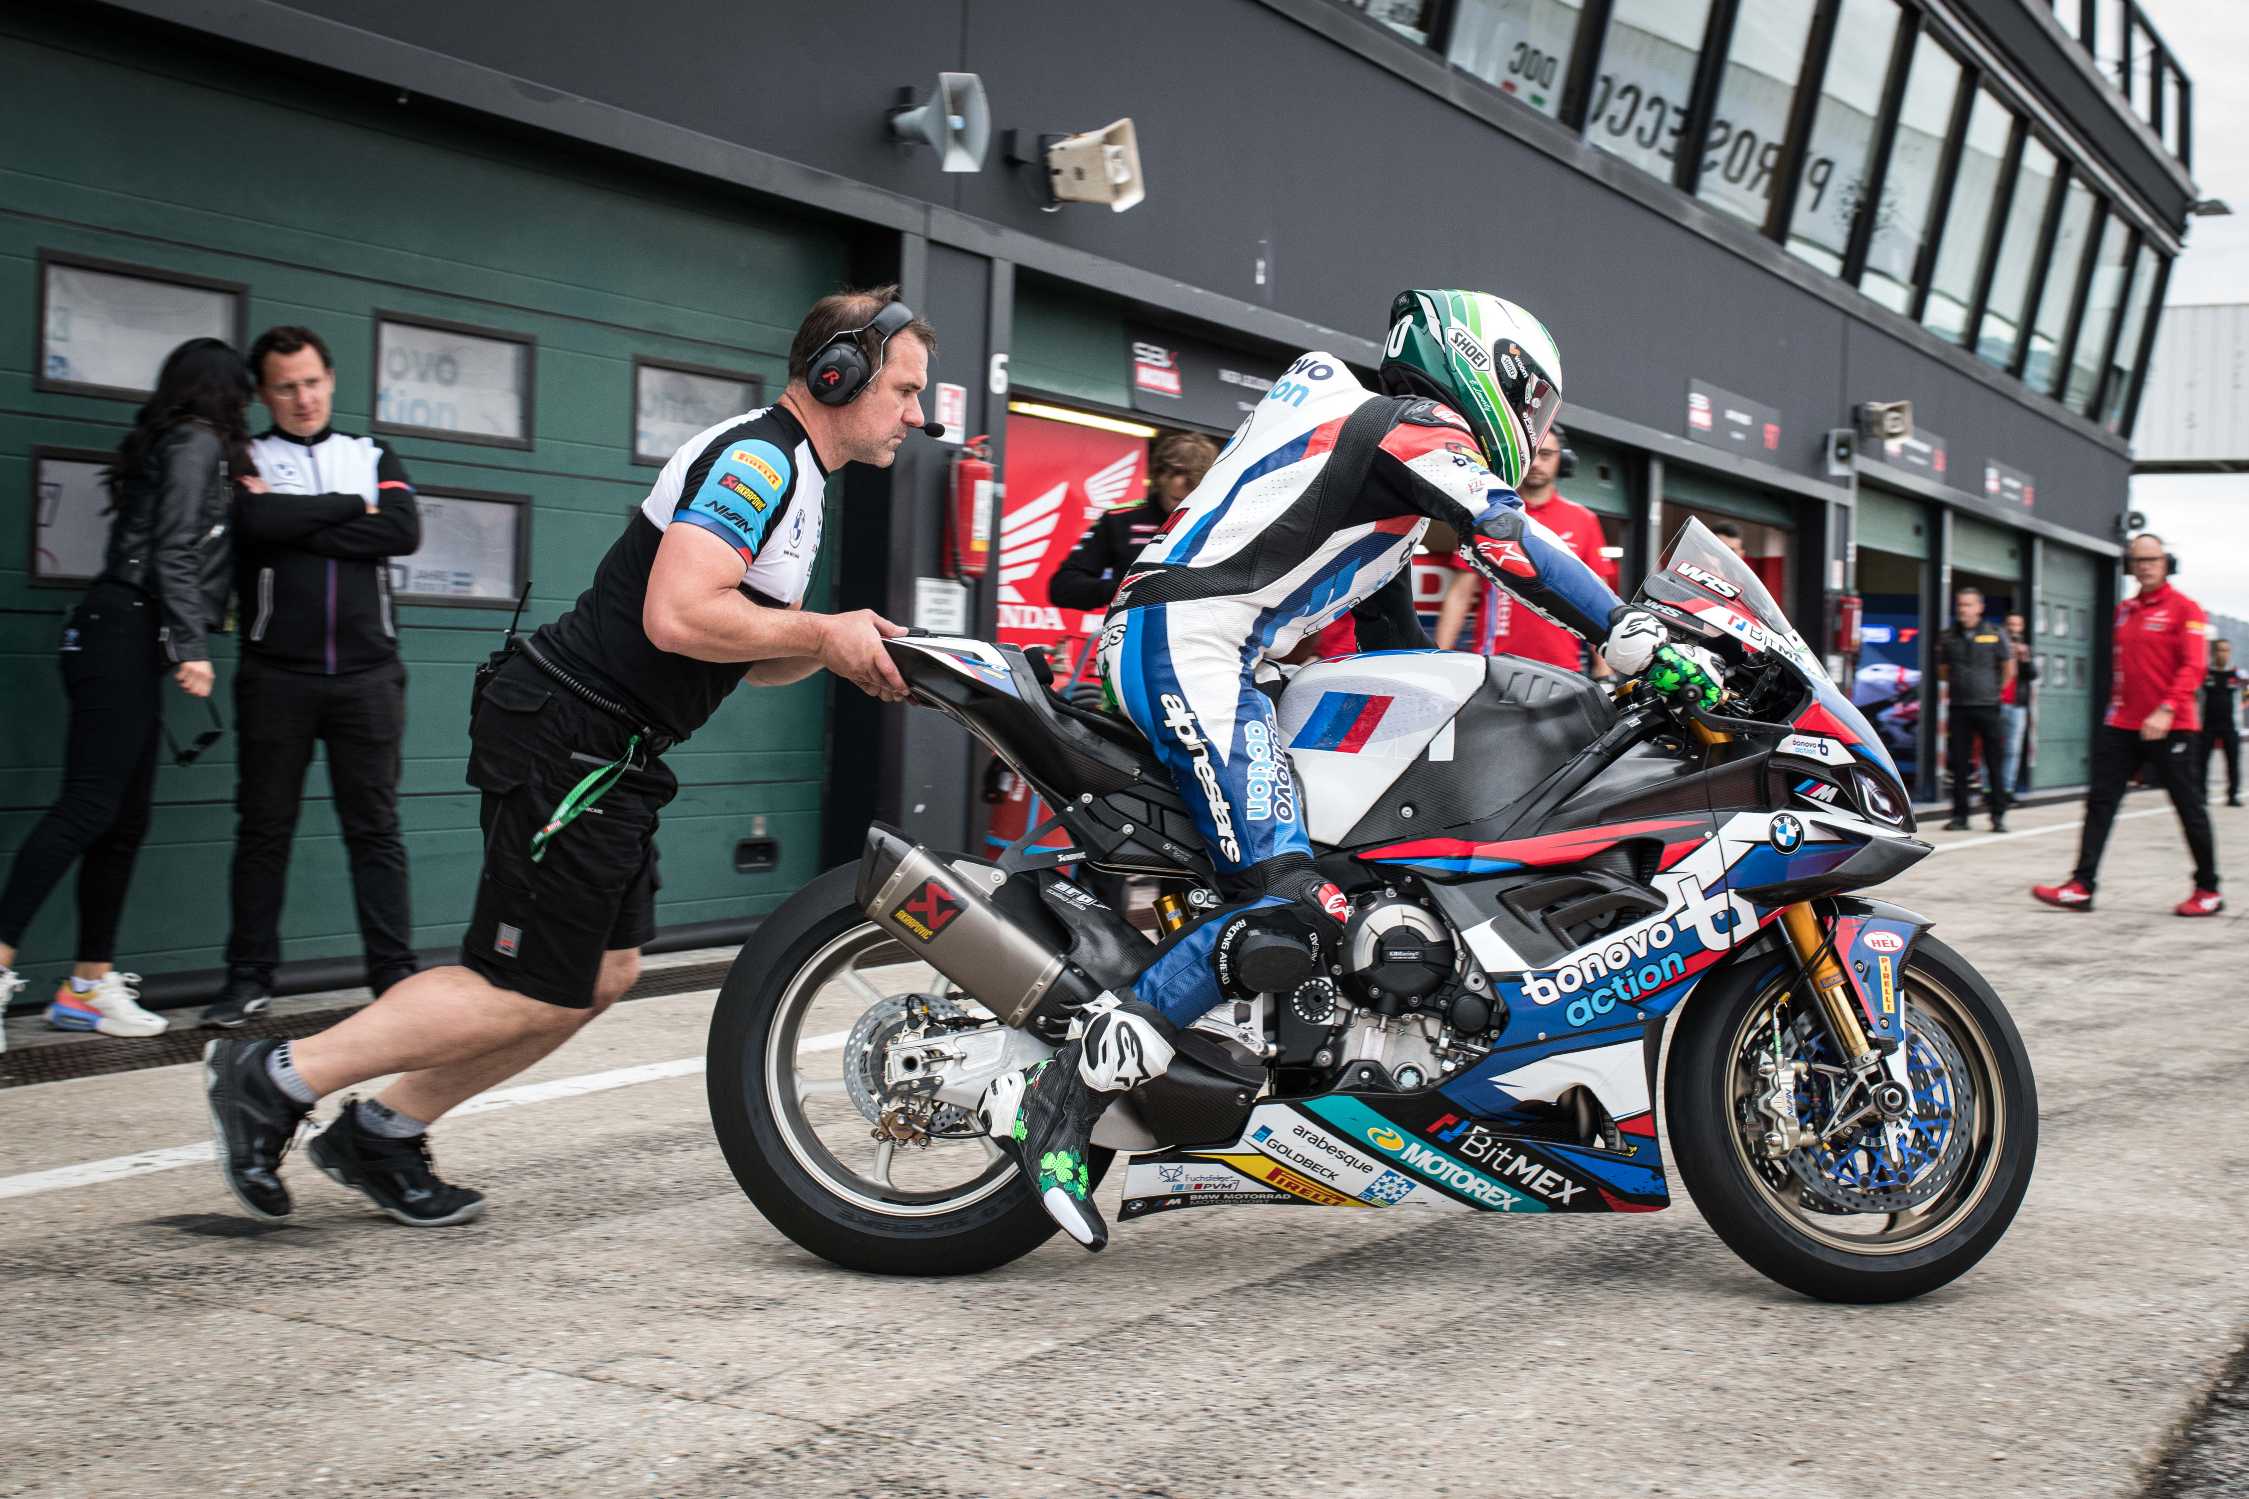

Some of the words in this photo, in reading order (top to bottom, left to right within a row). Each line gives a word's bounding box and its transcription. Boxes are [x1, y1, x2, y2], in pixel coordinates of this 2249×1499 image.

[1283, 358, 1334, 381] ovo
[1450, 332, 1488, 369] SHOEI
[990, 353, 1009, 394] 6
[736, 451, 781, 488] PIRELLI
[1676, 562, 1741, 599] WRS
[998, 604, 1066, 630] NDA
[1644, 600, 1683, 618] WRS
[1792, 738, 1817, 749] bonovo
[1160, 693, 1241, 863] alpinestars
[1244, 720, 1275, 821] action
[1221, 919, 1247, 950] RACING
[1871, 939, 1899, 949] HEL
[1219, 951, 1231, 985] AHEAD
[1521, 919, 1676, 1006] bonovo
[1565, 950, 1686, 1028] action
[1881, 957, 1891, 1011] PIRELLI
[1265, 1138, 1340, 1181] GOLDBECK
[1292, 1124, 1374, 1174] arabesque
[1459, 1126, 1587, 1207] BitMEX
[1203, 1183, 1233, 1191] PVM
[1265, 1166, 1348, 1207] PIRELLI
[1400, 1142, 1522, 1212] MOTOREX
